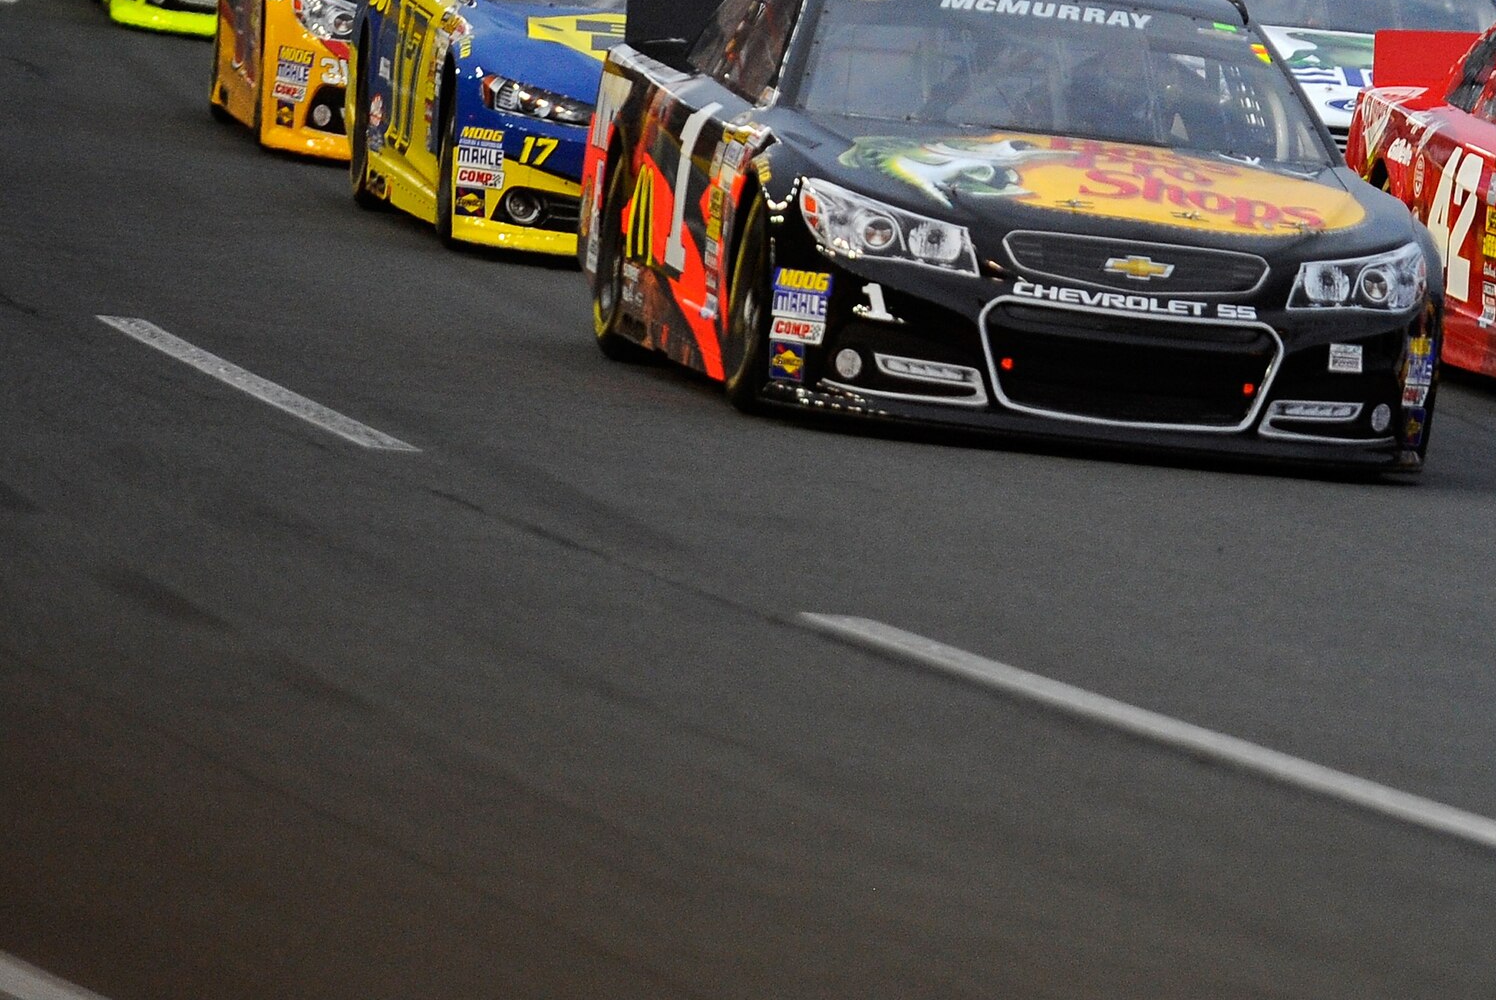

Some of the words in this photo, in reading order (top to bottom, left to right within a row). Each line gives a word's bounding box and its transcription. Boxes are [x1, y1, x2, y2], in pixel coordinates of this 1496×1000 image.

[280, 46, 314, 64] MOOG
[320, 57, 349, 86] 31
[460, 126, 504, 142] MOOG
[458, 147, 503, 166] MAHLE
[519, 136, 559, 166] 17
[458, 169, 493, 185] COMP
[664, 101, 723, 273] 1
[1079, 168, 1325, 229] Shops
[1427, 146, 1484, 303] 42
[775, 268, 830, 292] MOOG
[773, 291, 827, 317] MAHLE
[858, 282, 894, 321] 1
[1012, 281, 1207, 316] CHEVROLET
[1217, 304, 1257, 319] SS
[775, 320, 811, 339] COMP
